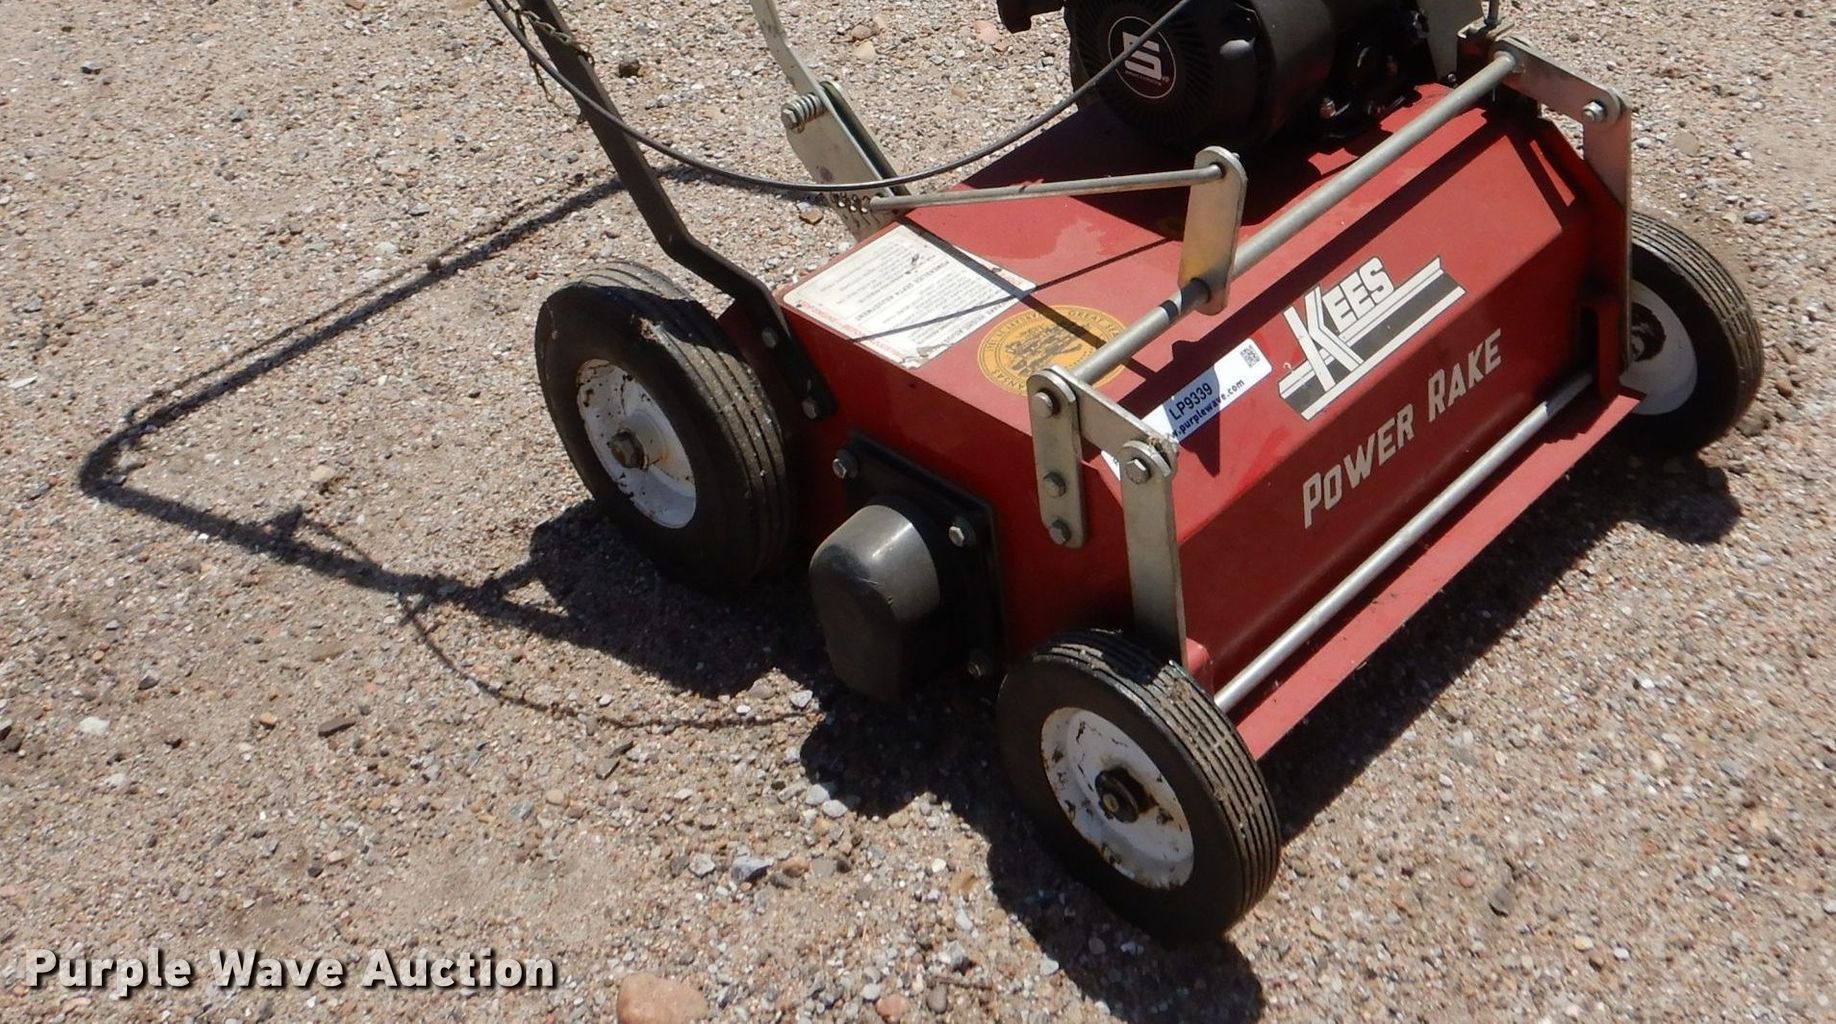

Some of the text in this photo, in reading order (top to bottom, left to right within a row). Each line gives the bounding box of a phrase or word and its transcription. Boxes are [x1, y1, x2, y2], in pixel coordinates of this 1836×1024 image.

[1283, 256, 1395, 392] KEES
[1169, 382, 1213, 421] LP9339
[1301, 327, 1502, 529] POWER RAKE
